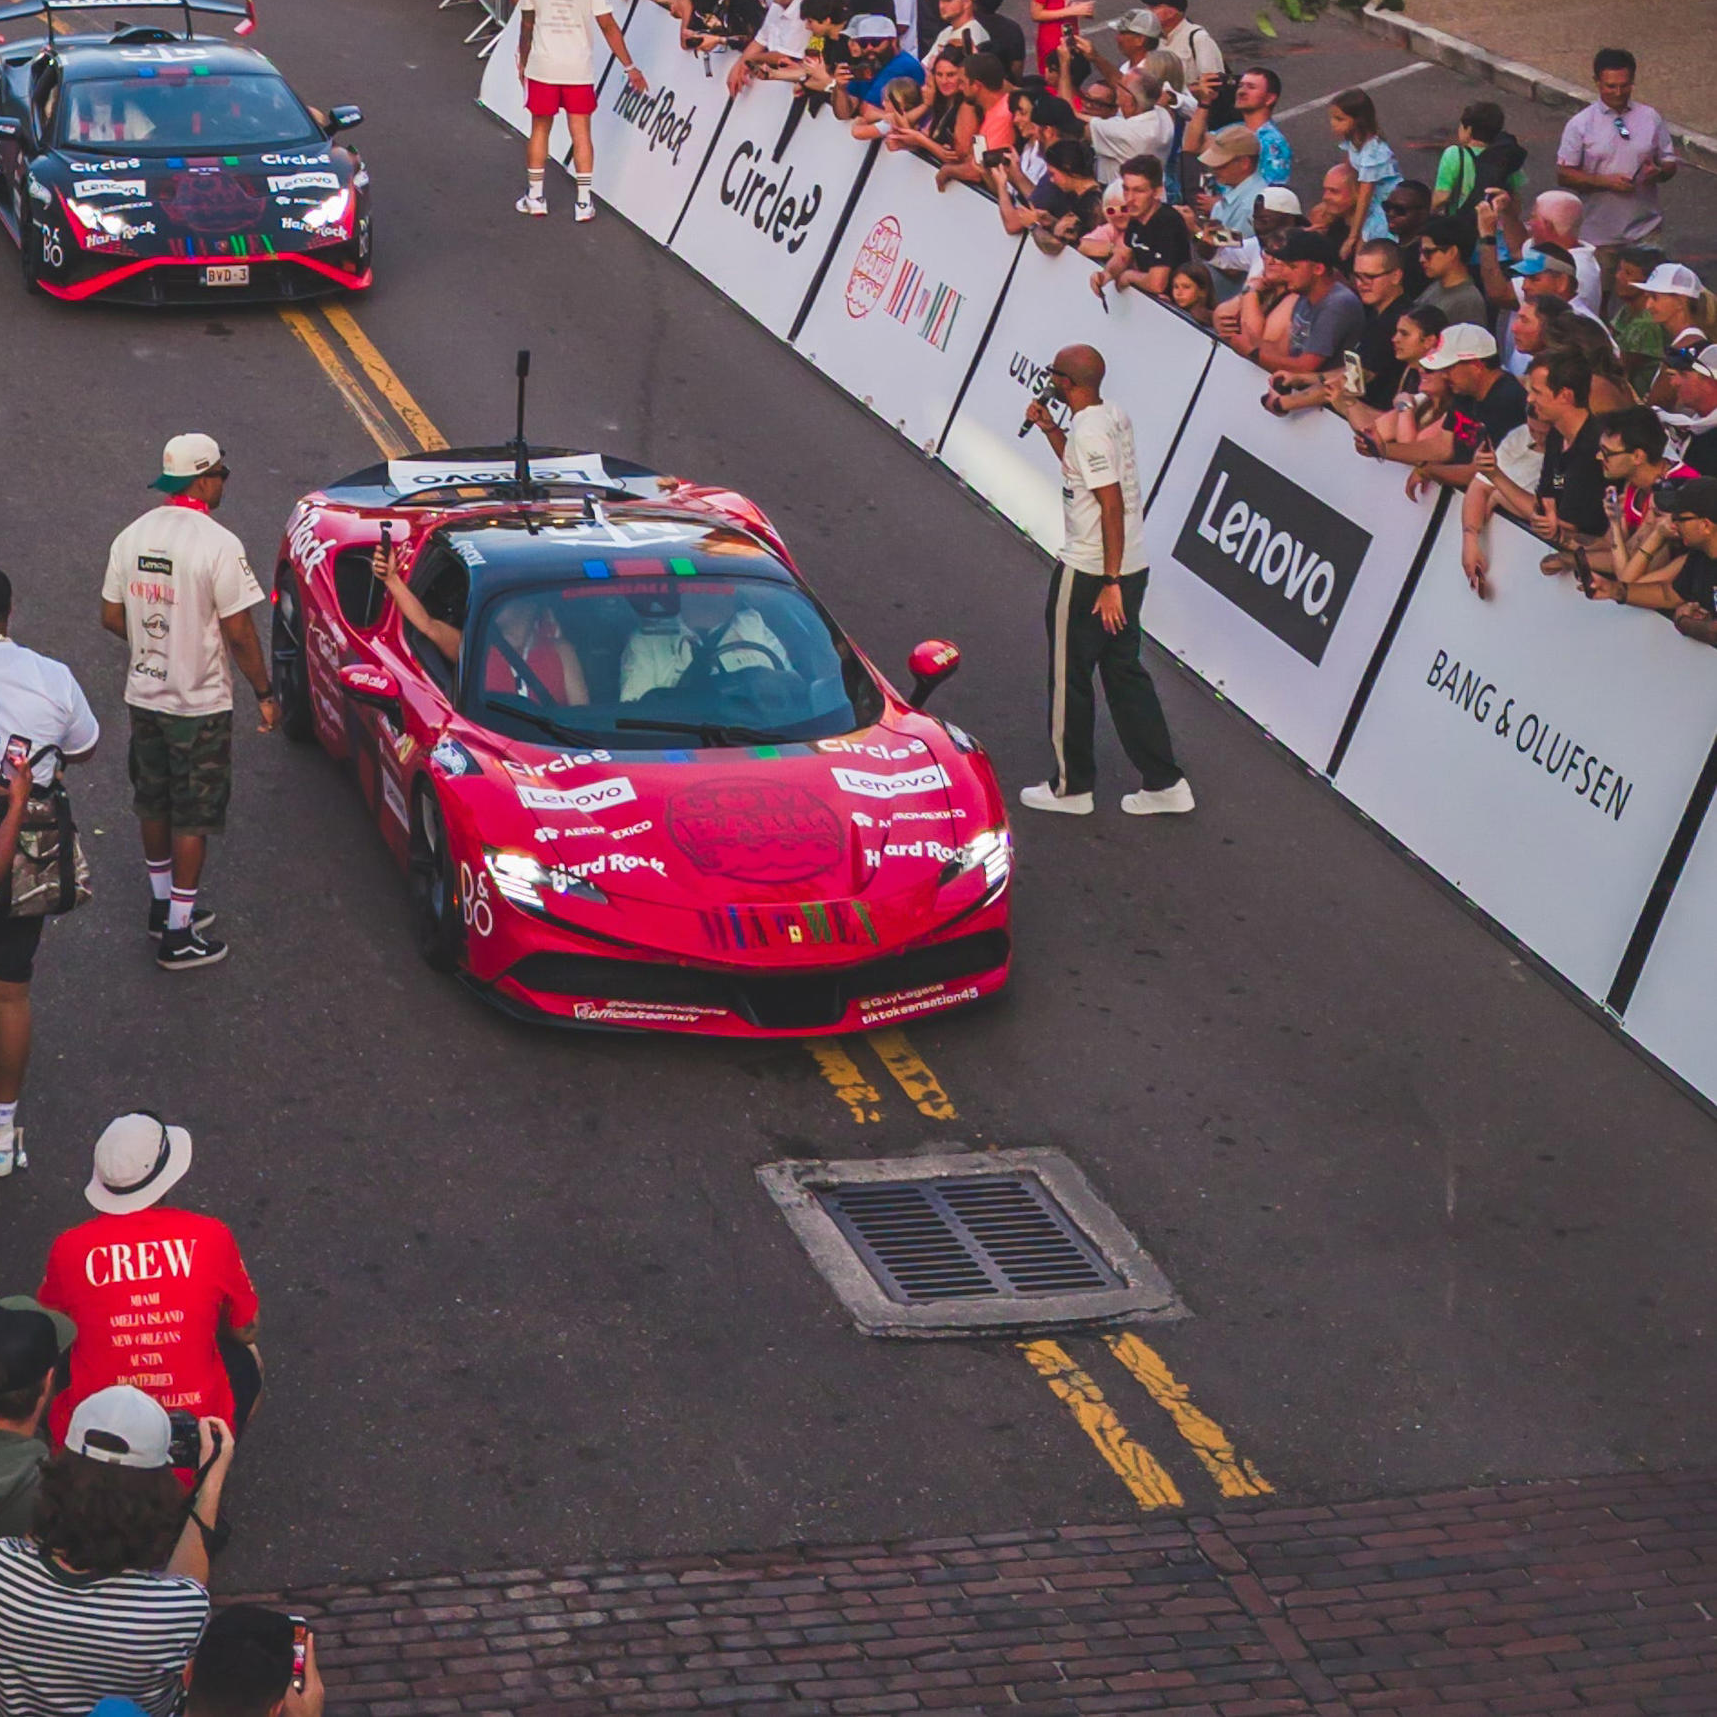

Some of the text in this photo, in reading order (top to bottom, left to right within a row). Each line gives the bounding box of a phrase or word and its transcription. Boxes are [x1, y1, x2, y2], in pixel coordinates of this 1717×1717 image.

[648, 90, 697, 166] Rock
[81, 182, 139, 197] Lenovo
[122, 220, 157, 241] Rock
[916, 281, 968, 354] MEX
[1196, 469, 1336, 617] Lenovo
[1426, 648, 1634, 822] BANG & OLUFSEN
[844, 773, 937, 793] Lenovo
[528, 786, 622, 807] Lenovo
[563, 819, 653, 841] AEROEXICO
[864, 840, 923, 869] Hard
[85, 1238, 198, 1288] CREW
[130, 1292, 161, 1308] MIAMI
[109, 1309, 184, 1328] AMELIA ISLAND
[111, 1330, 182, 1348] NEW ORLEANS
[130, 1352, 163, 1367] AUSTIN
[161, 1391, 202, 1408] ALLENDE
